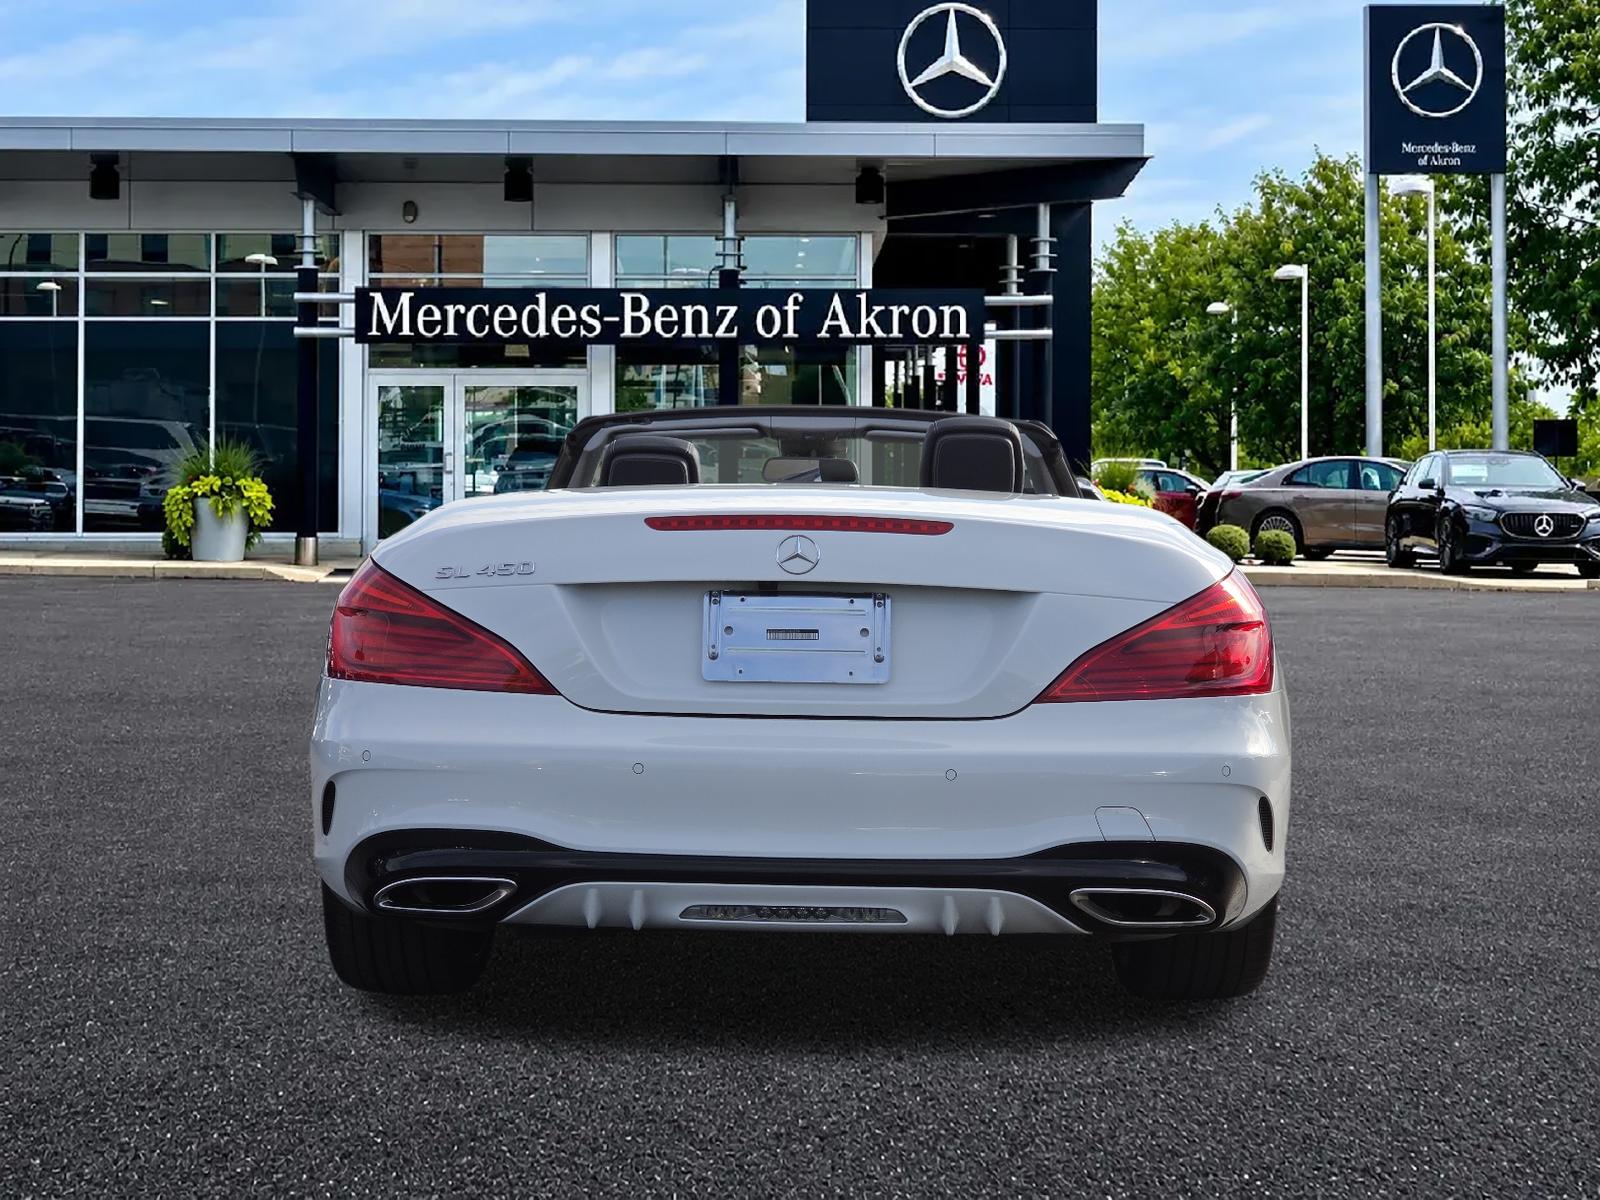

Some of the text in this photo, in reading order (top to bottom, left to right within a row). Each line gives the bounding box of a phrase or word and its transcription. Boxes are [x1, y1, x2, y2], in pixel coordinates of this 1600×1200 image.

[1401, 141, 1476, 153] Mercedes-Benz
[1417, 154, 1461, 166] of Akron
[367, 291, 971, 338] Mercedes-Benz of Akron
[435, 559, 536, 579] SL 450
